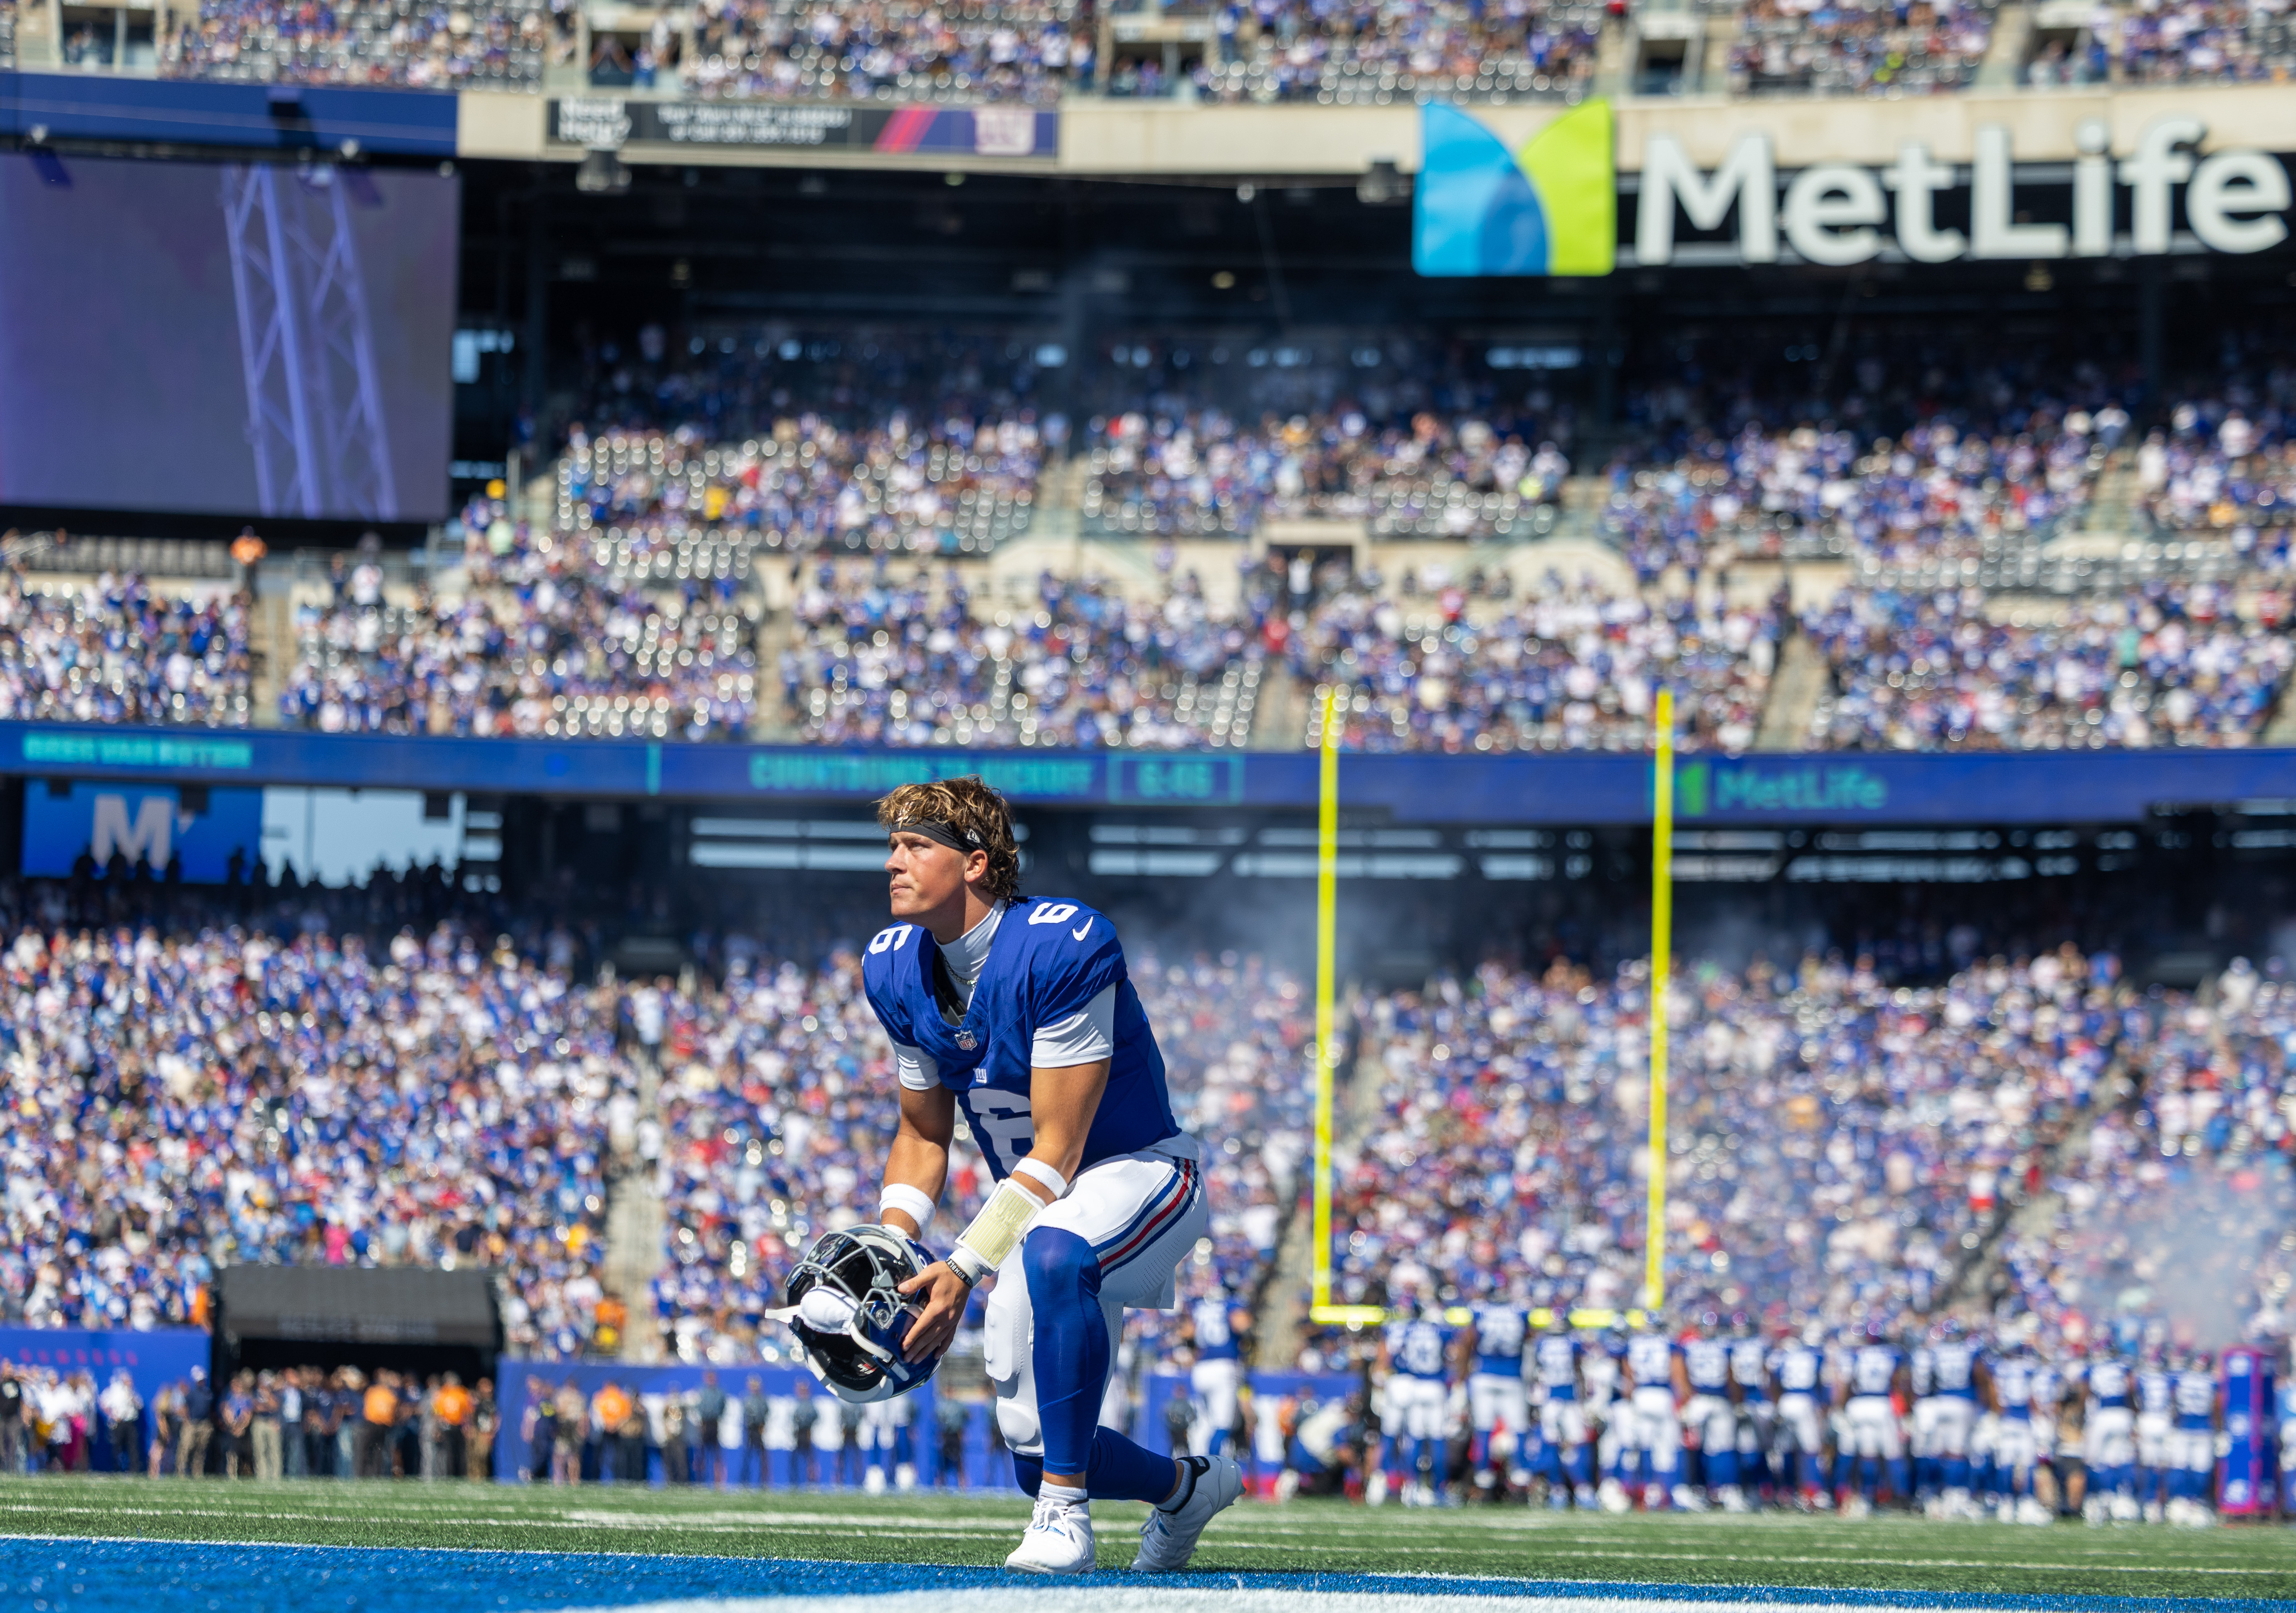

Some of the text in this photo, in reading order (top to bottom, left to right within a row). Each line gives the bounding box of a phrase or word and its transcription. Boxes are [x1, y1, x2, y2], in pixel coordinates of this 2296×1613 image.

[1635, 117, 2292, 266] MetLife
[1717, 763, 1886, 809] MetLife
[1028, 902, 1078, 925] 6
[868, 924, 913, 955] 6
[960, 1039, 974, 1048] NFL
[968, 1088, 1035, 1176] 6
[947, 1260, 965, 1279] HUMBLE
